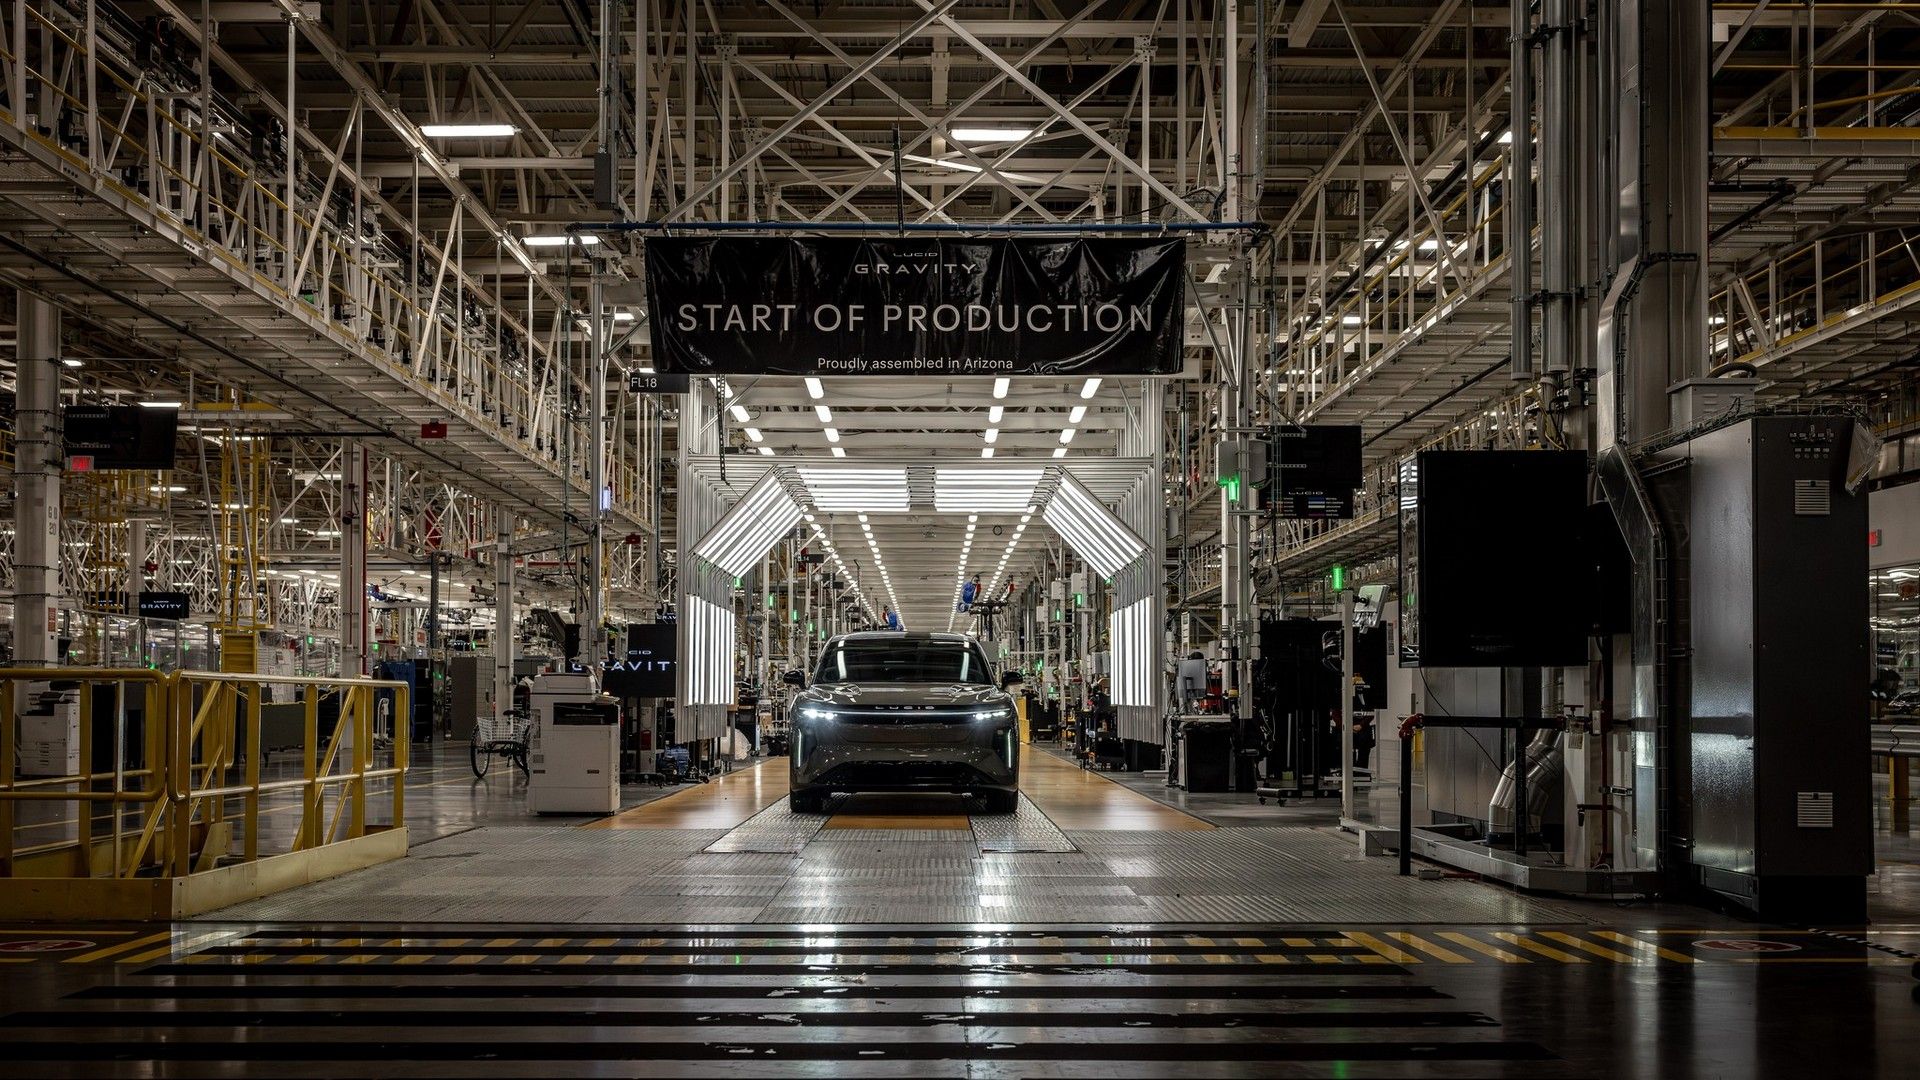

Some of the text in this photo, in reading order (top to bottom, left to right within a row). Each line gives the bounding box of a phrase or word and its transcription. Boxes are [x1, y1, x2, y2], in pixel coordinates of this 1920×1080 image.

[854, 263, 977, 275] GRAVITY
[678, 303, 1151, 333] START OF PRODUCTION
[817, 357, 1014, 371] Proudly assembled in Arizona
[631, 377, 658, 388] FL18
